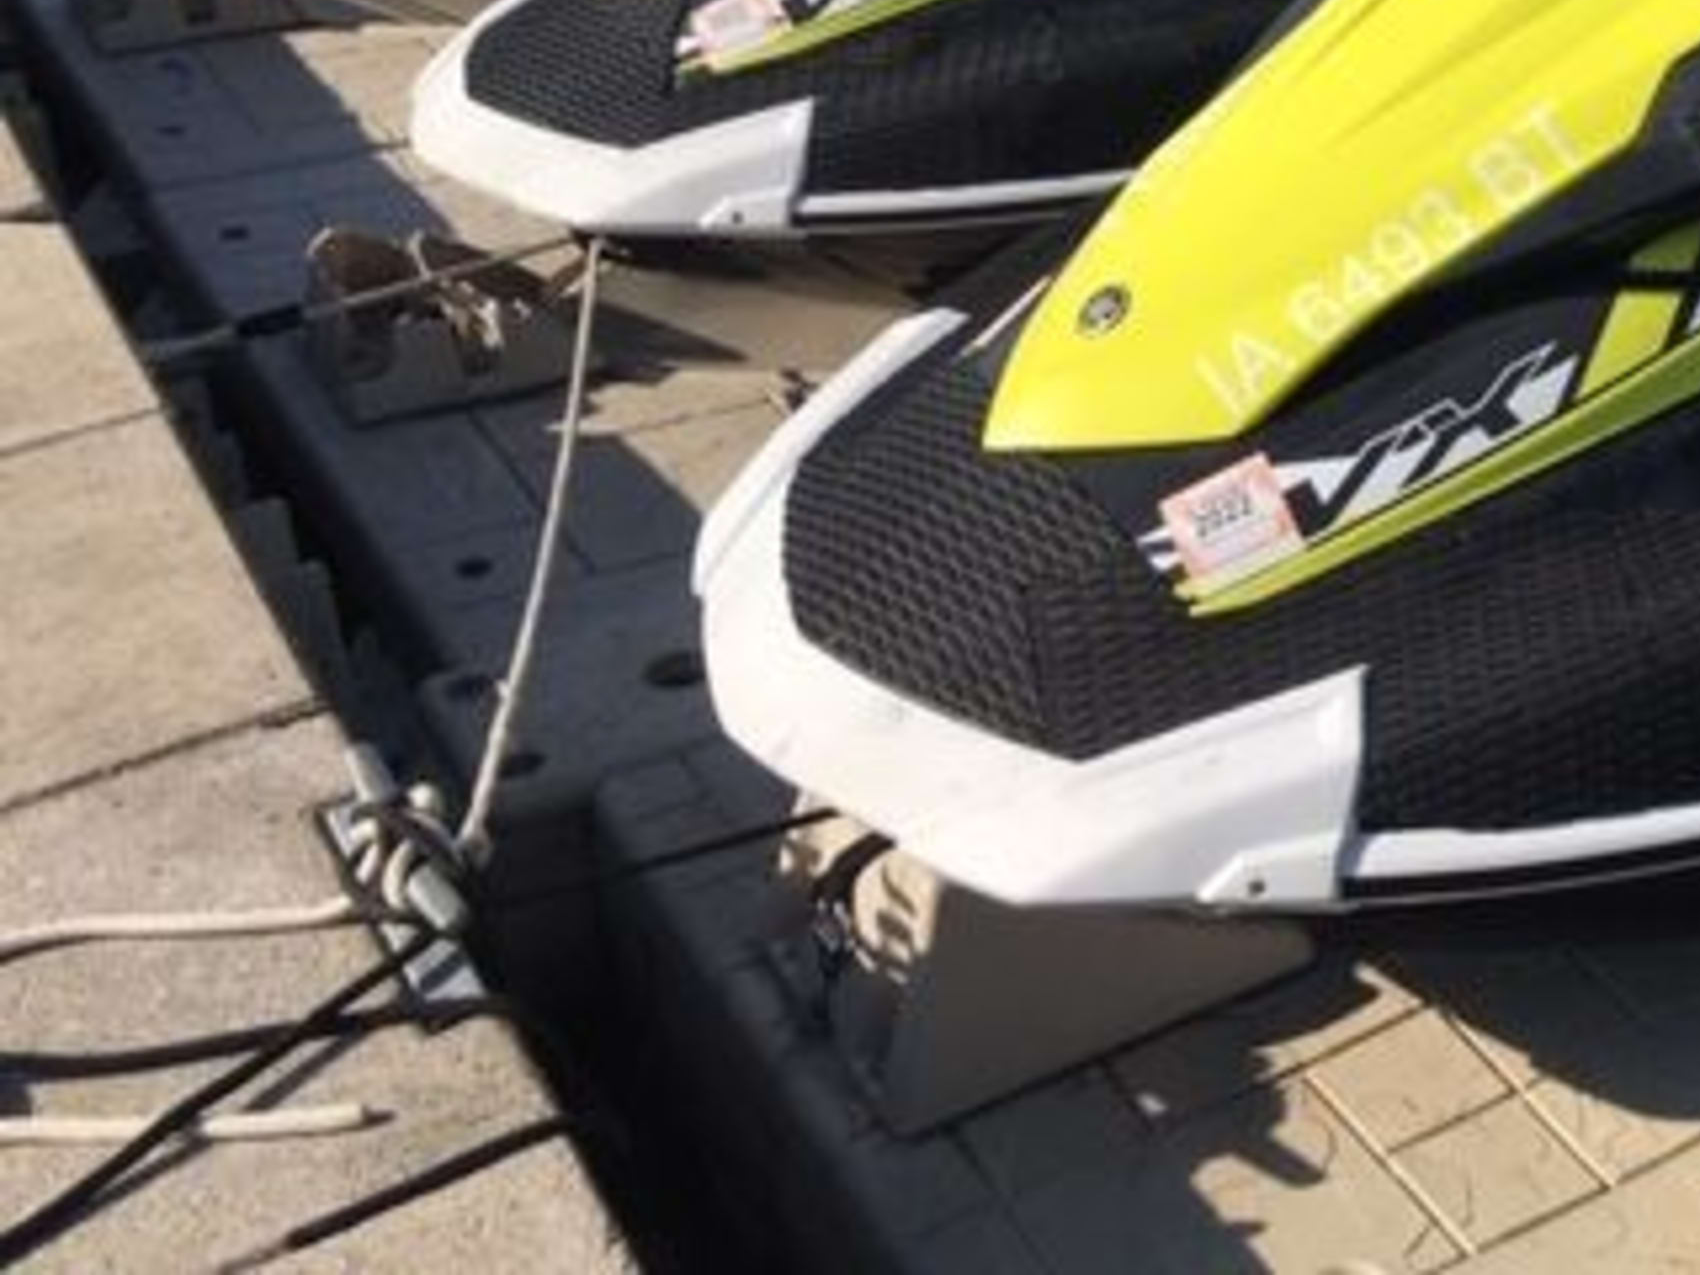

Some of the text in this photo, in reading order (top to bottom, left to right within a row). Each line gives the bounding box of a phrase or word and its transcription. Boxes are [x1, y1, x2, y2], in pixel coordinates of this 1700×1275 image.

[1195, 102, 1584, 422] IA 6493 BT
[1284, 340, 1568, 541] VX
